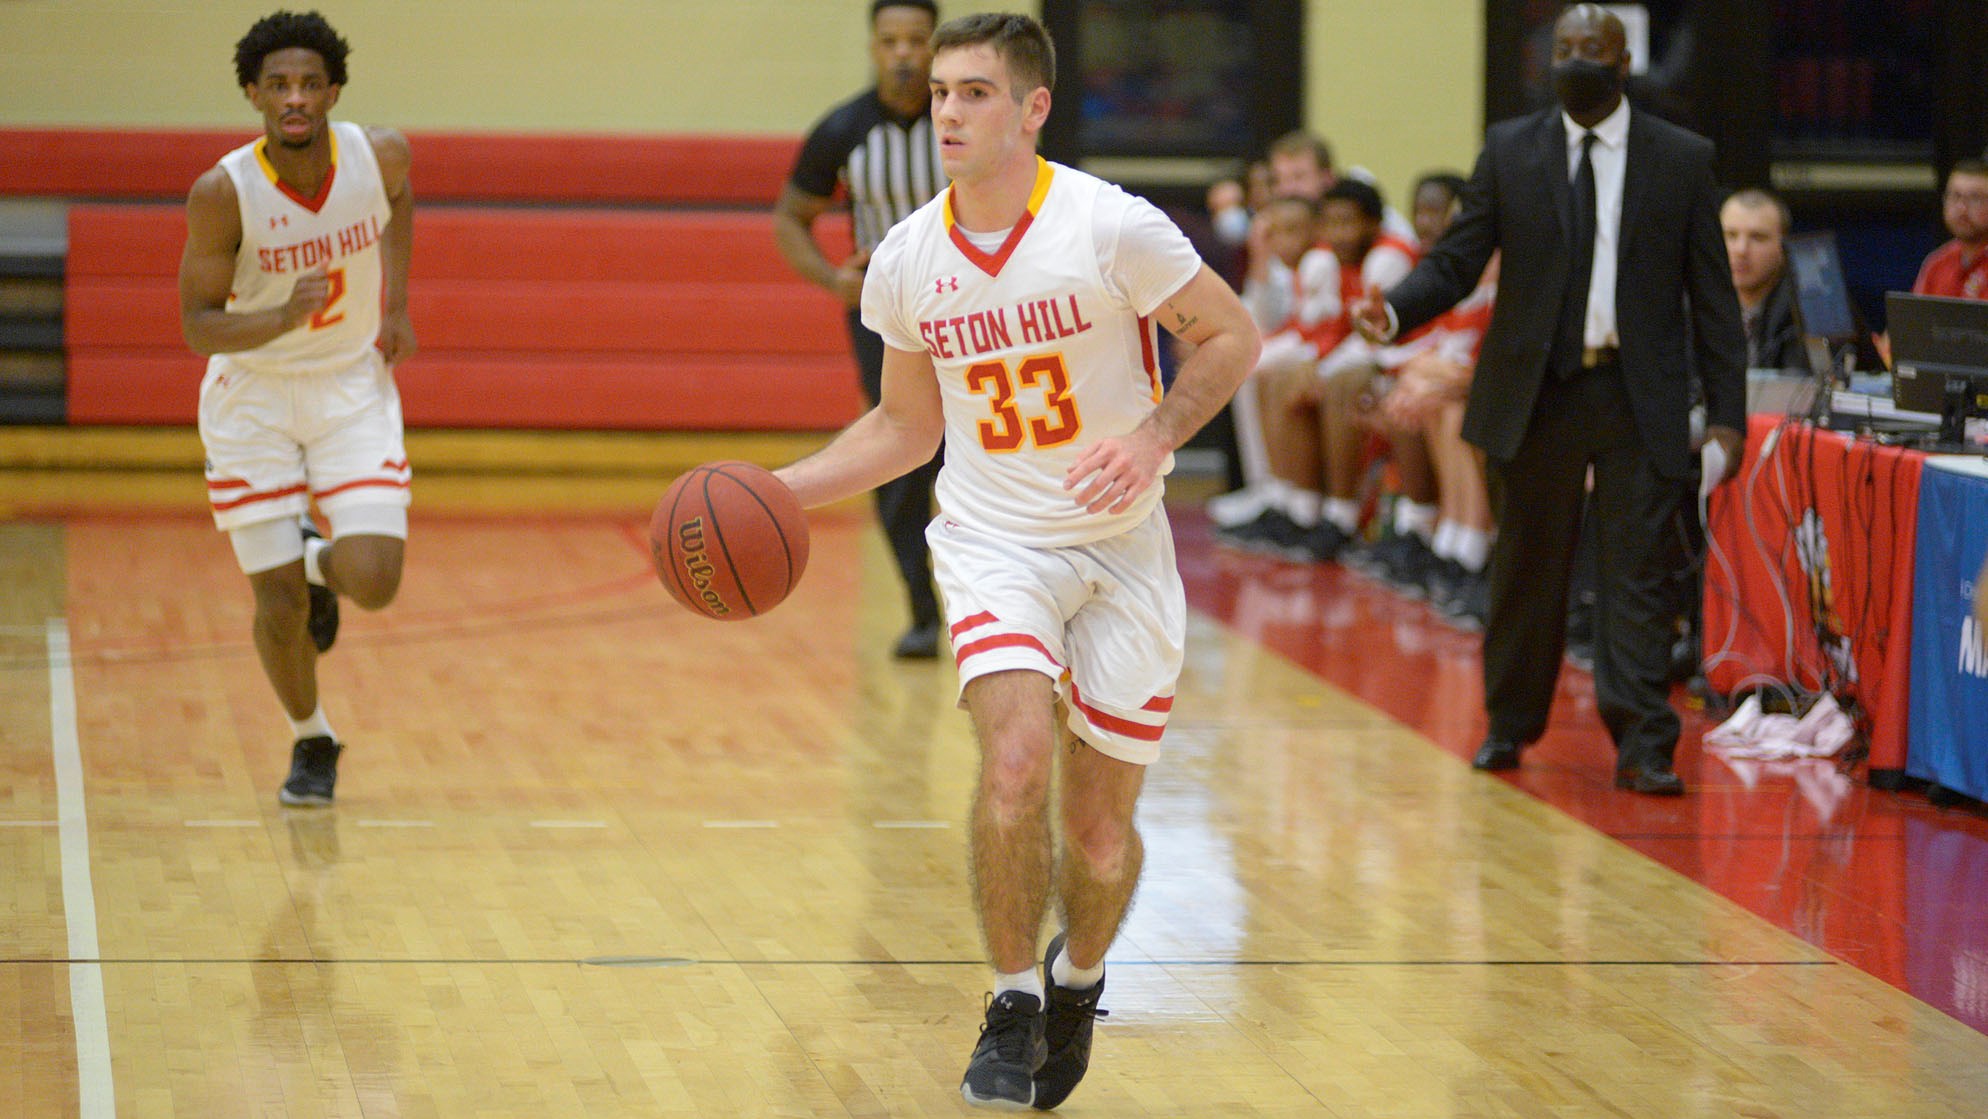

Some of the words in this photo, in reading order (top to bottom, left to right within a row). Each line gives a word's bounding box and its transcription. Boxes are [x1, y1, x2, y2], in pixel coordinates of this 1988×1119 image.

[258, 234, 333, 272] SETON
[338, 214, 380, 257] HILL
[919, 308, 1013, 358] SETON
[1017, 294, 1092, 344] HILL
[964, 352, 1082, 453] 33
[680, 516, 731, 615] Wilson
[1958, 615, 1988, 678] M
